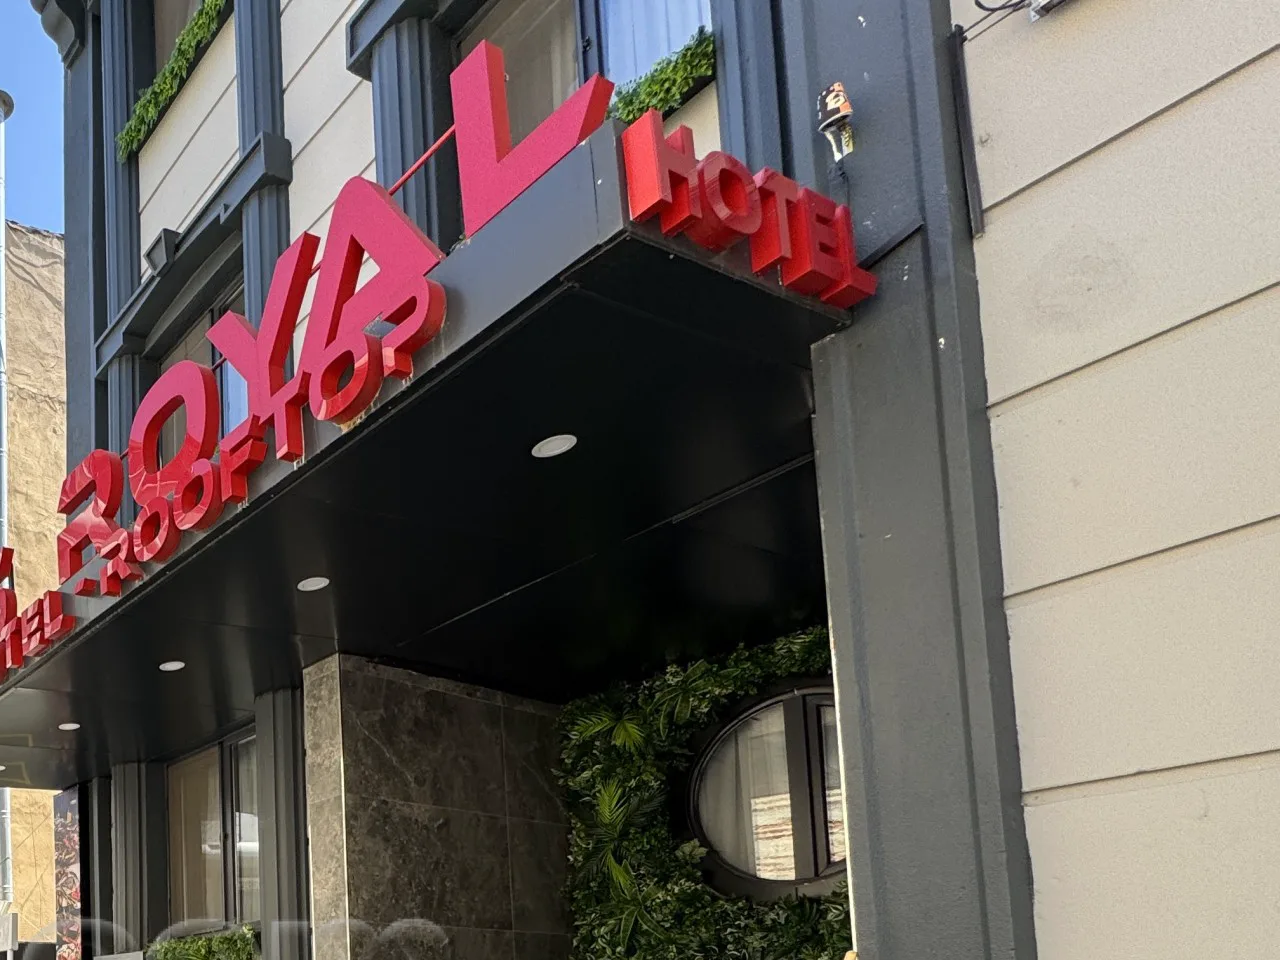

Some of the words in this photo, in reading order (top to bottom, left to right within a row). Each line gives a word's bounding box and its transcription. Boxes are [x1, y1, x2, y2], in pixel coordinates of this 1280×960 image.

[57, 40, 614, 585] ROYAL
[622, 108, 878, 309] HOTEL
[99, 278, 447, 597] ROOFTOP
